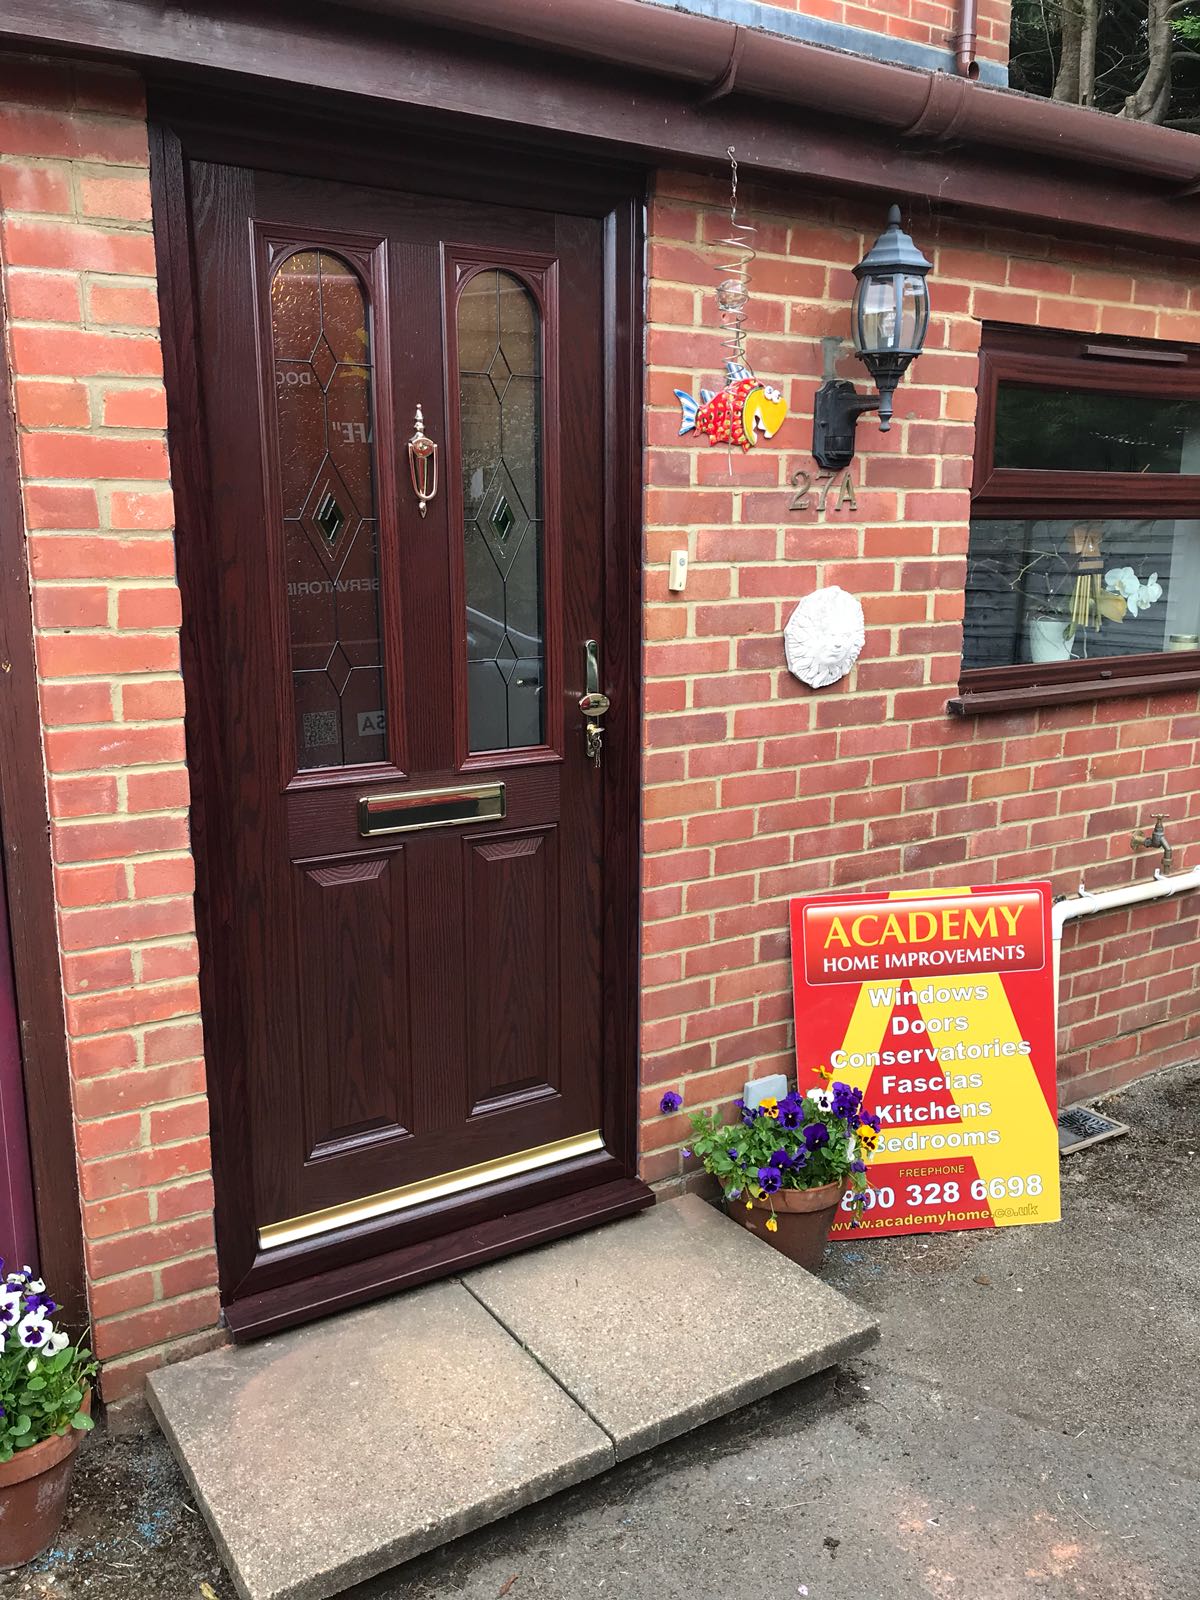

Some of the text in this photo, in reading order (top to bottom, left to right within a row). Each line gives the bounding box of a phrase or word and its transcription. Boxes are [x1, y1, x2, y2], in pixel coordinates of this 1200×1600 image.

[789, 470, 857, 511] 27A
[823, 904, 1025, 949] ACADEMY
[823, 944, 1026, 973] HOME IMPROVEMENTS
[868, 984, 989, 1007] Windows
[892, 1014, 969, 1036] Doors
[830, 1039, 1032, 1069] Conservatories
[881, 1071, 983, 1095] Fascias
[875, 1099, 993, 1124] Kitchens
[899, 1164, 966, 1178] FREEPHONE
[905, 1181, 961, 1207] 328
[970, 1173, 1043, 1201] 6698
